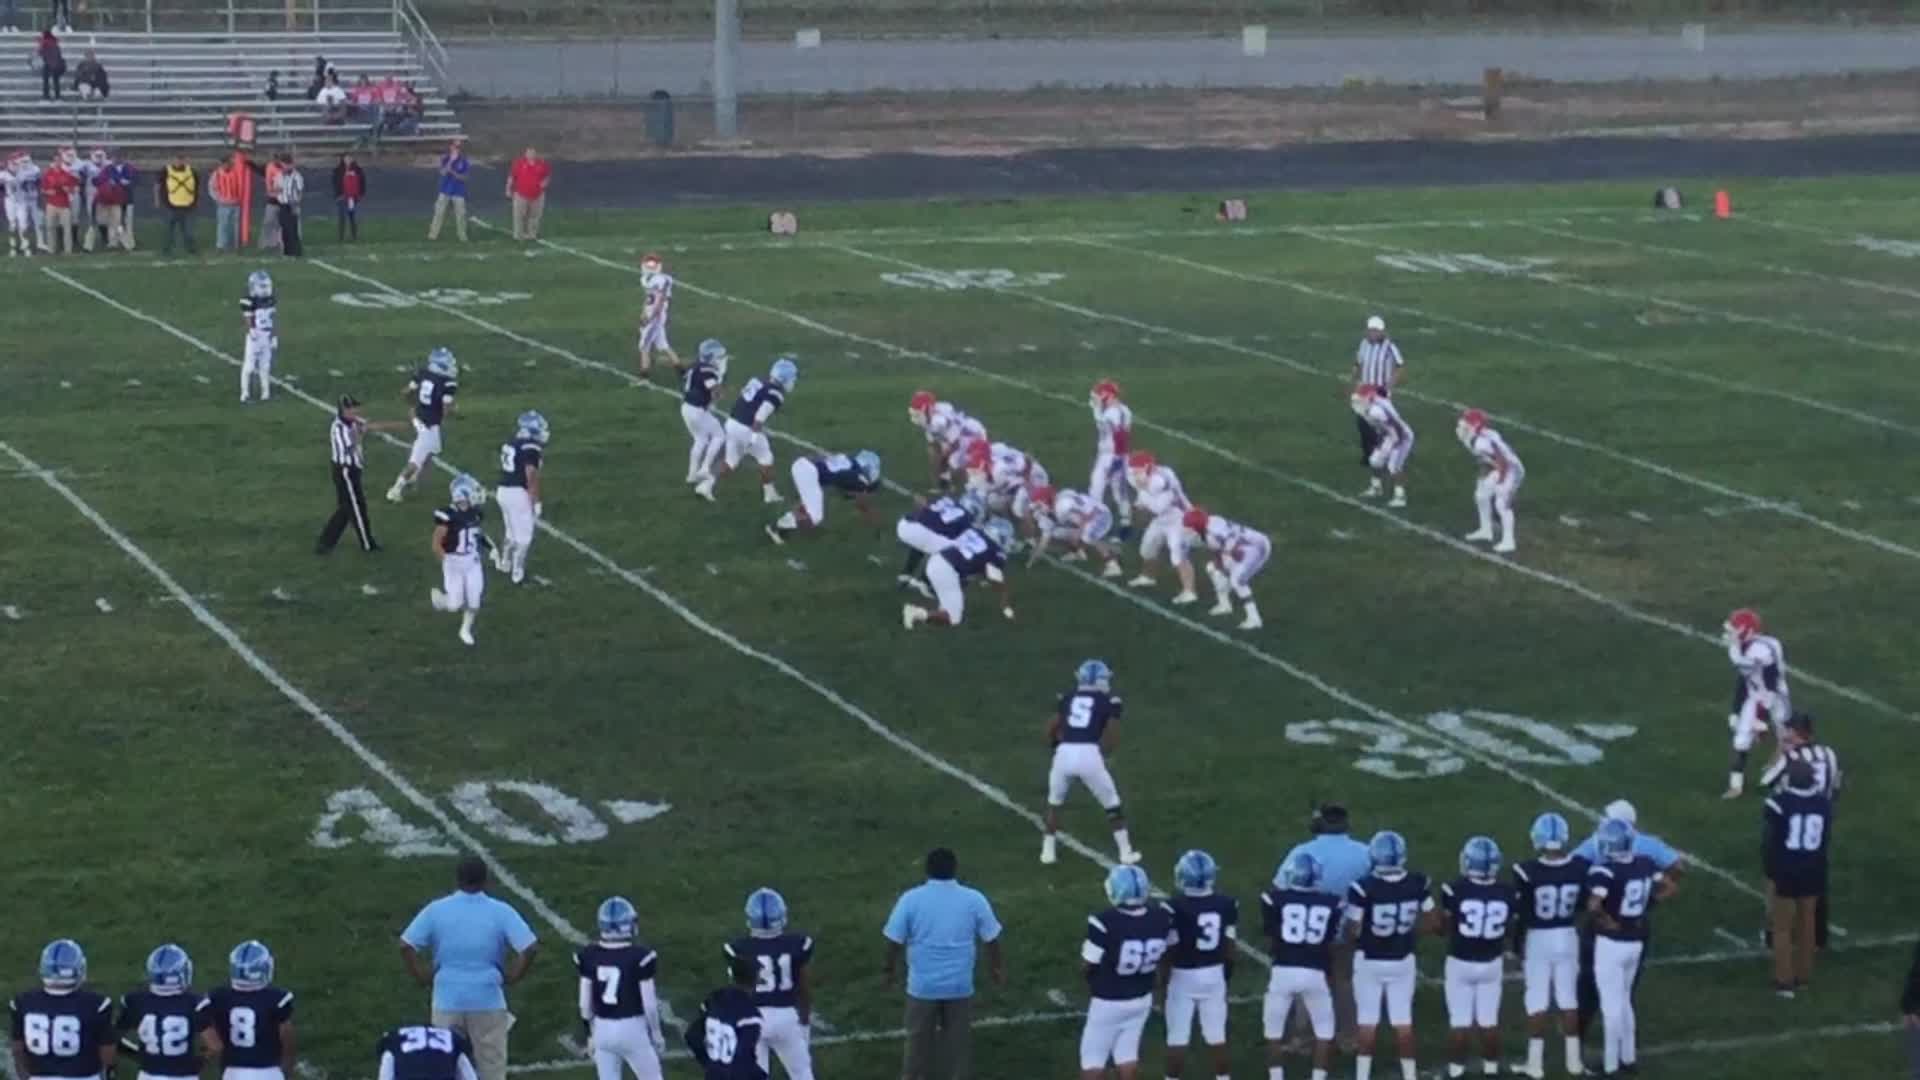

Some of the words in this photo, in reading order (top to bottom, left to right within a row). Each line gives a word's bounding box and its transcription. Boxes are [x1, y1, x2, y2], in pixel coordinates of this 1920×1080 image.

[1066, 695, 1094, 728] 5
[1785, 813, 1822, 851] 18
[1194, 911, 1221, 951] 3
[1281, 902, 1332, 945] 89
[1369, 900, 1417, 938] 55
[1458, 898, 1505, 940] 32
[594, 965, 620, 1005] 7
[755, 953, 793, 992] 31
[24, 1013, 81, 1056] 66
[138, 1013, 190, 1056] 42
[228, 1006, 255, 1048] 8
